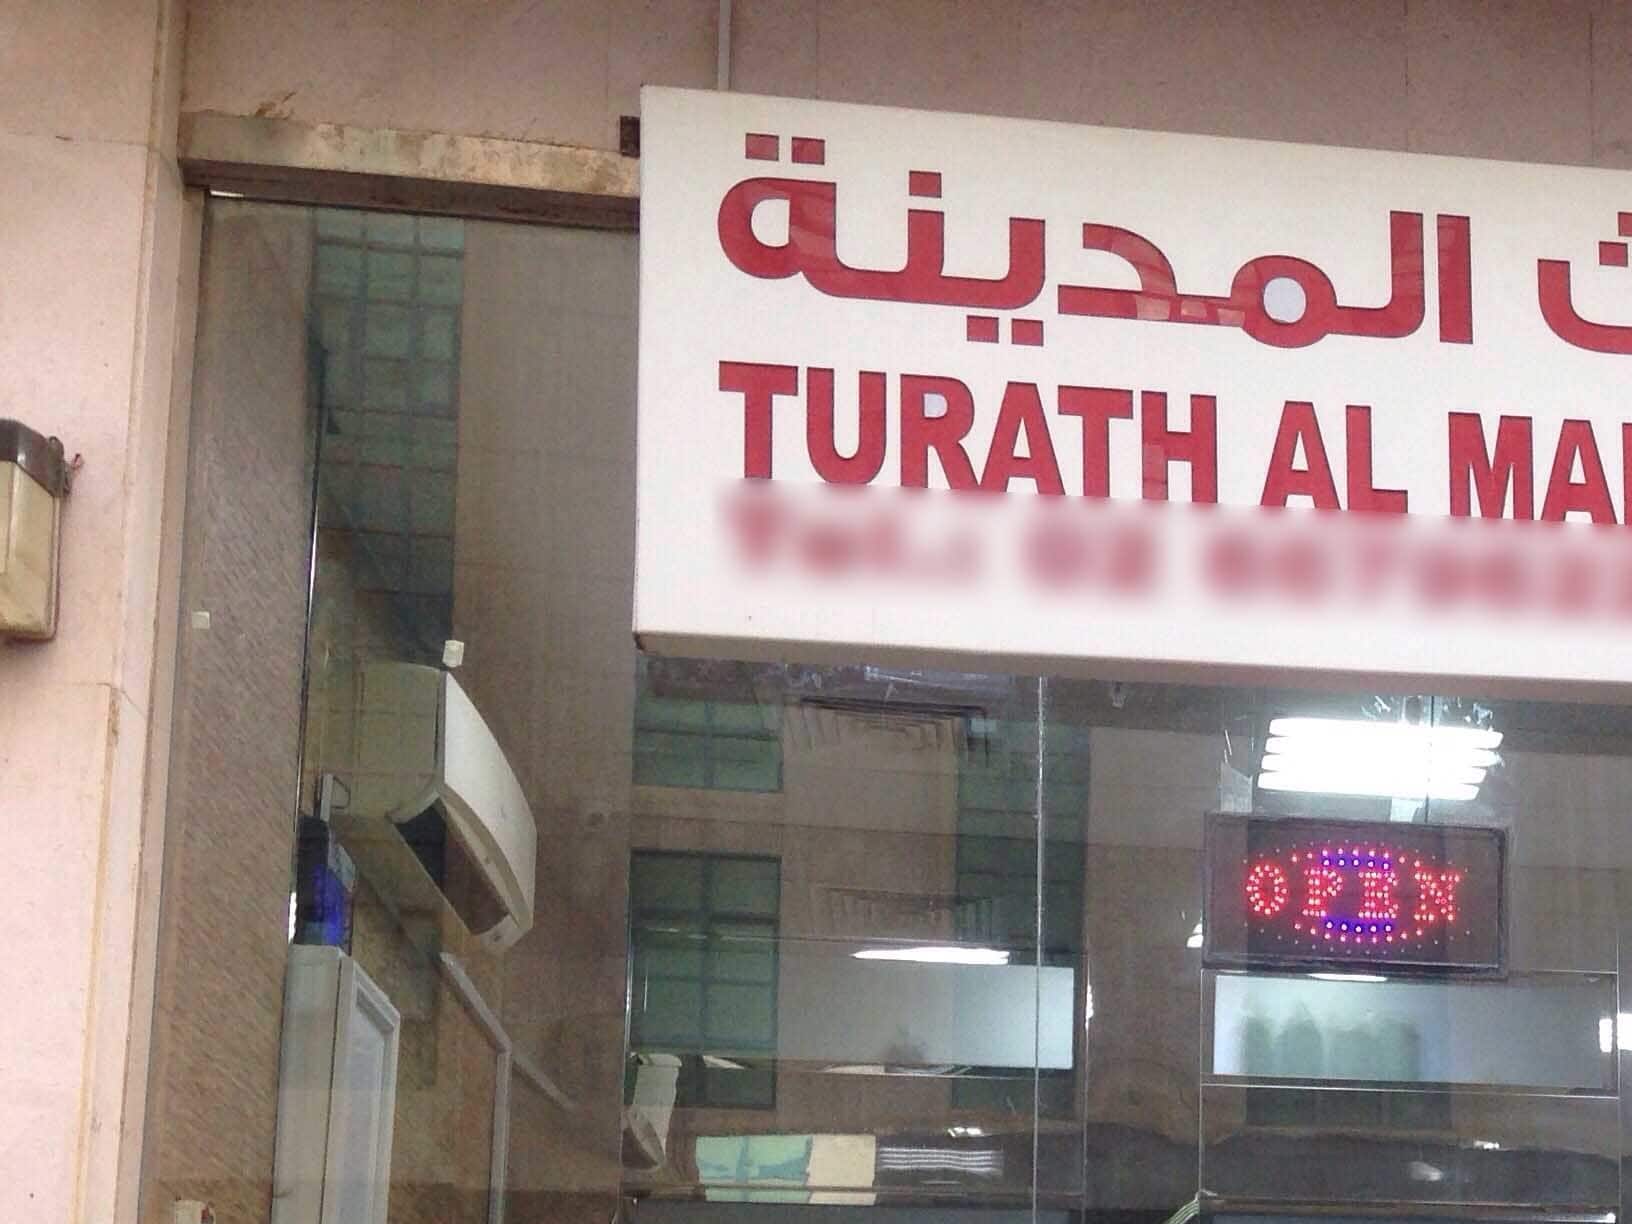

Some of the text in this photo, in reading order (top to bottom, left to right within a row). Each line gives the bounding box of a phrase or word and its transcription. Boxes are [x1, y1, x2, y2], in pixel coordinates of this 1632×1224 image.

[717, 132, 1474, 348] المدينة
[718, 361, 1218, 503] TURATH
[1260, 400, 1408, 514] AL
[1246, 863, 1462, 922] OPEN
